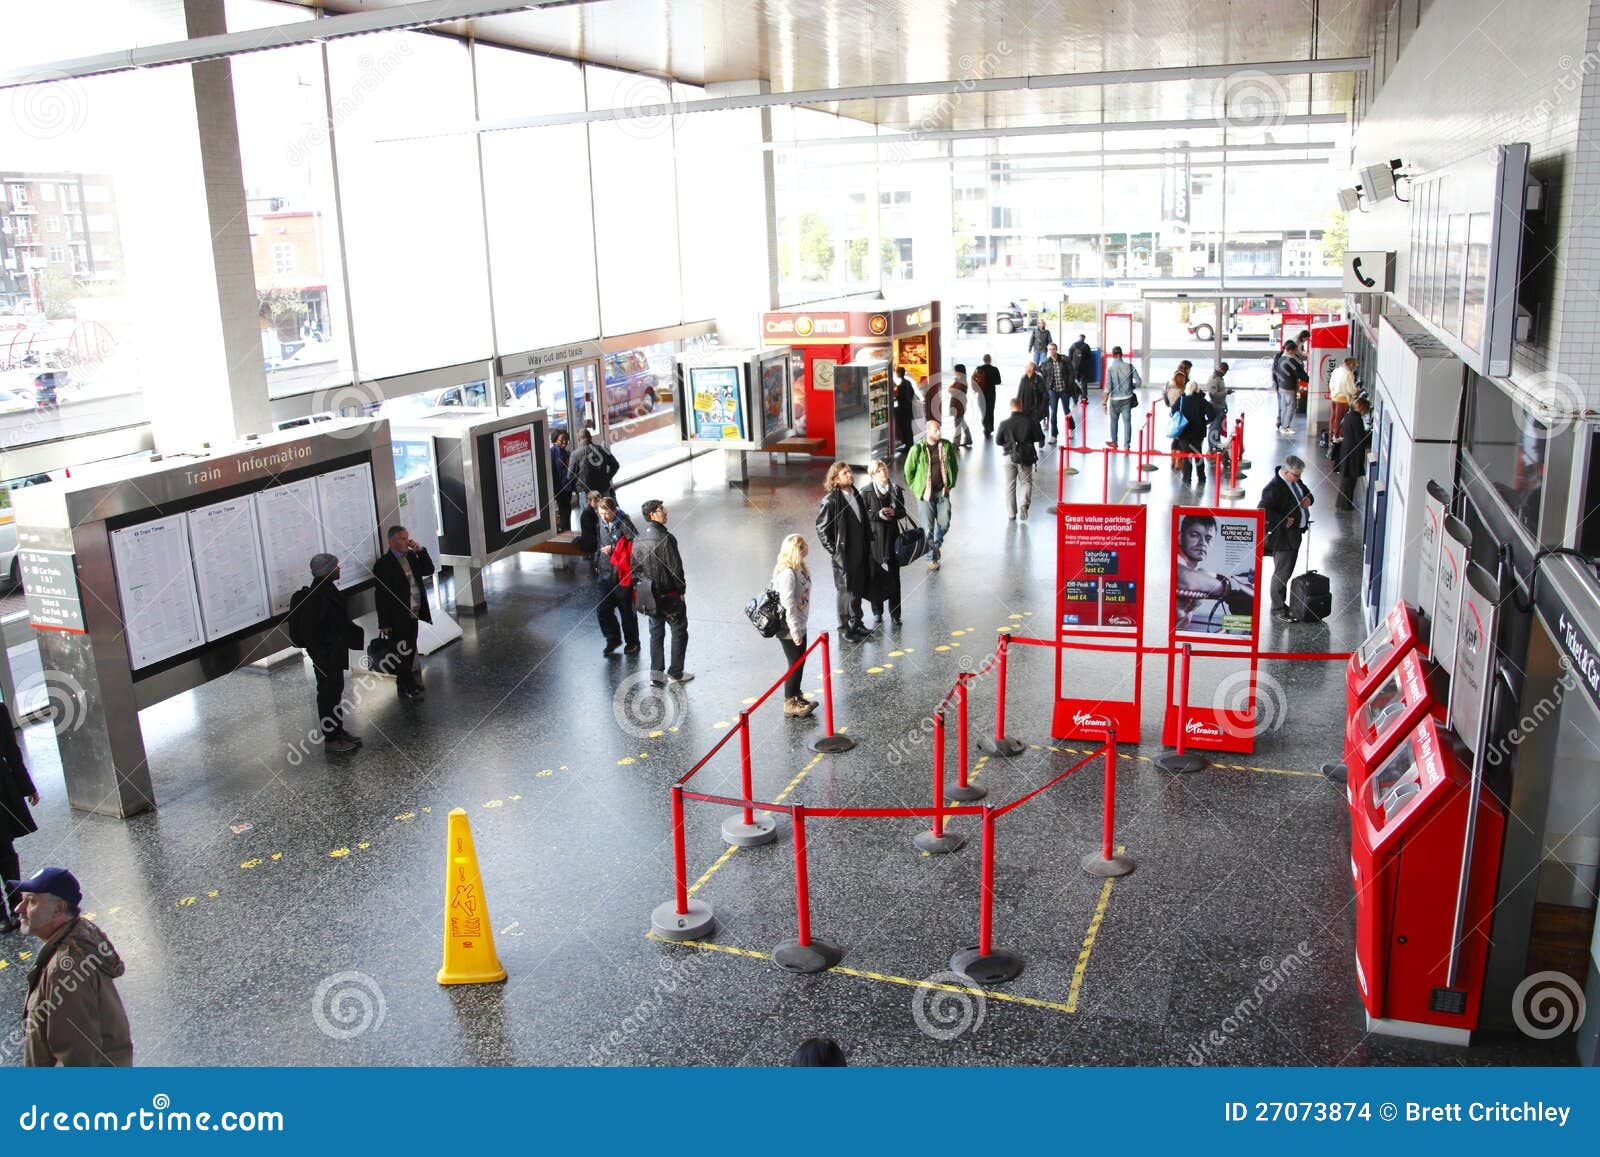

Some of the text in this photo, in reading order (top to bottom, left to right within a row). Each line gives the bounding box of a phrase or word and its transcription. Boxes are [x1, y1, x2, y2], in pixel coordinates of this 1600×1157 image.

[528, 354, 542, 366] Way
[184, 444, 312, 488] Train Information
[1104, 524, 1132, 532] optional
[1566, 622, 1582, 664] Ticket
[1588, 658, 1600, 690] Car
